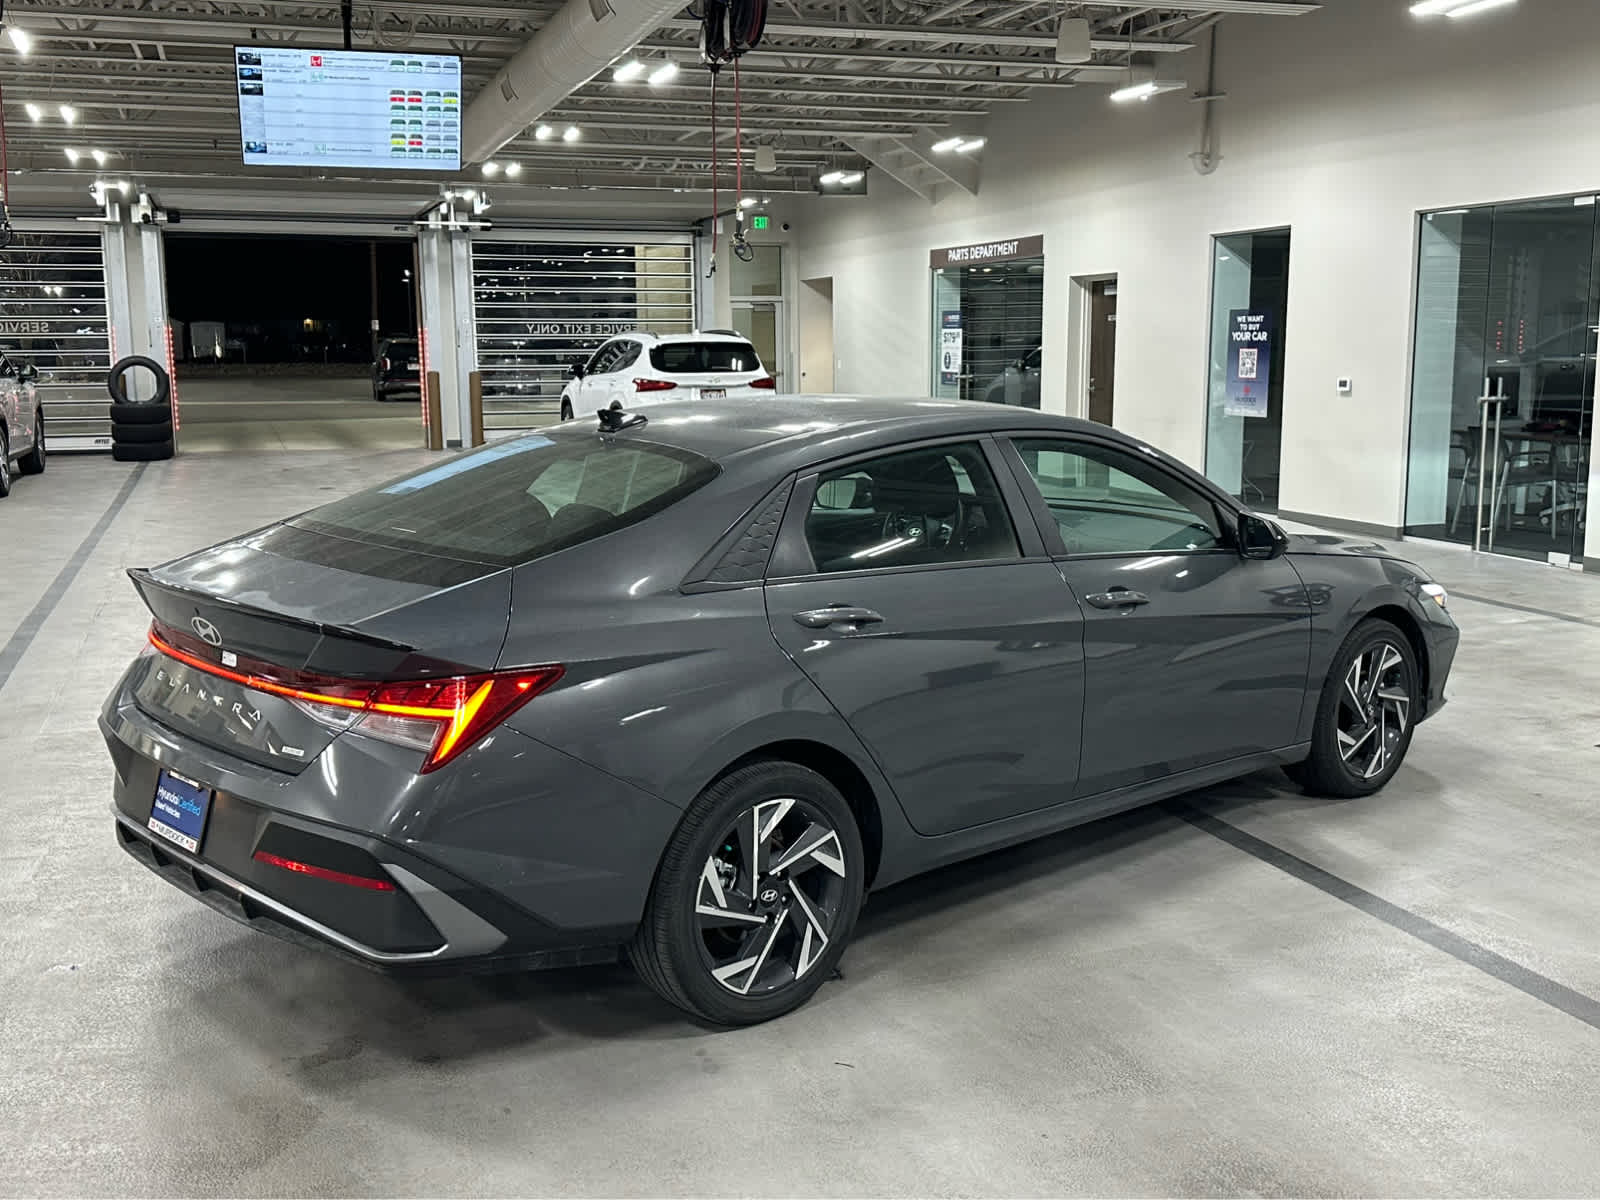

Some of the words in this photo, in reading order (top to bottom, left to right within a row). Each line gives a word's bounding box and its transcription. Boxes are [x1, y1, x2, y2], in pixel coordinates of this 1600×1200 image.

[948, 248, 969, 262] PARTS
[969, 241, 1019, 260] DEPARTMENT
[1237, 315, 1247, 323] WE
[1247, 314, 1264, 323] WANT
[1240, 323, 1248, 331] TO
[1248, 323, 1260, 331] BUY
[1231, 331, 1252, 341] YOUR
[1252, 331, 1268, 341] CAR
